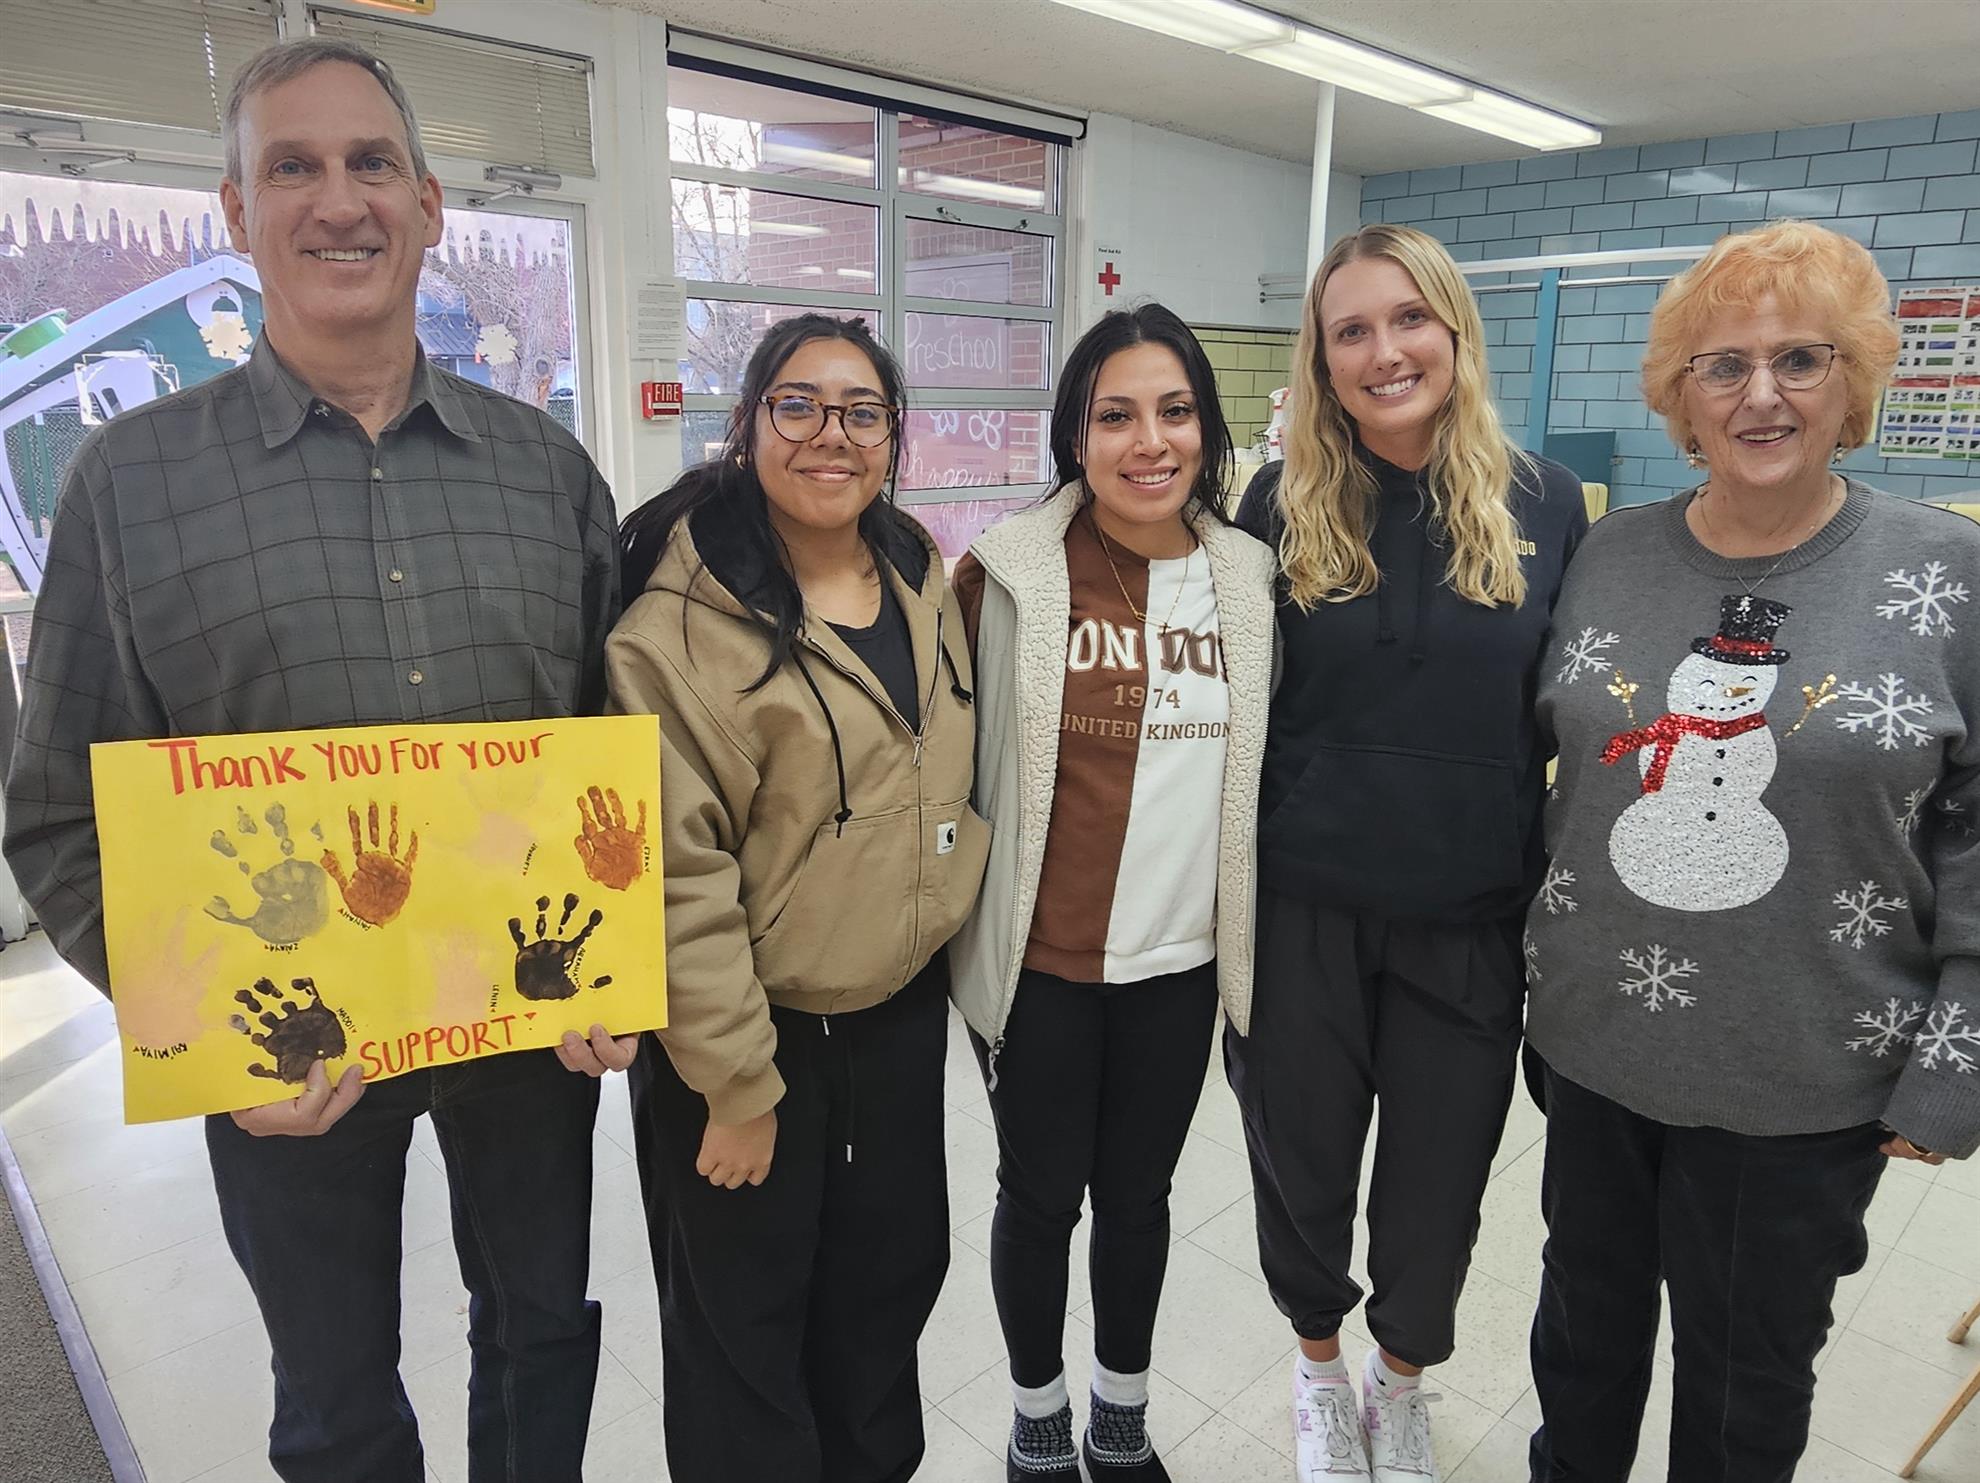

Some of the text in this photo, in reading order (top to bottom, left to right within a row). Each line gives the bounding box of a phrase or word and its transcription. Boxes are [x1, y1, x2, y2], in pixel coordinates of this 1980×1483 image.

[655, 384, 680, 402] FIRE
[1067, 617, 1229, 683] ONDO
[1114, 684, 1181, 709] 1974
[147, 739, 307, 796] Thank
[389, 738, 444, 774] For
[359, 1014, 516, 1080] SUPPORT
